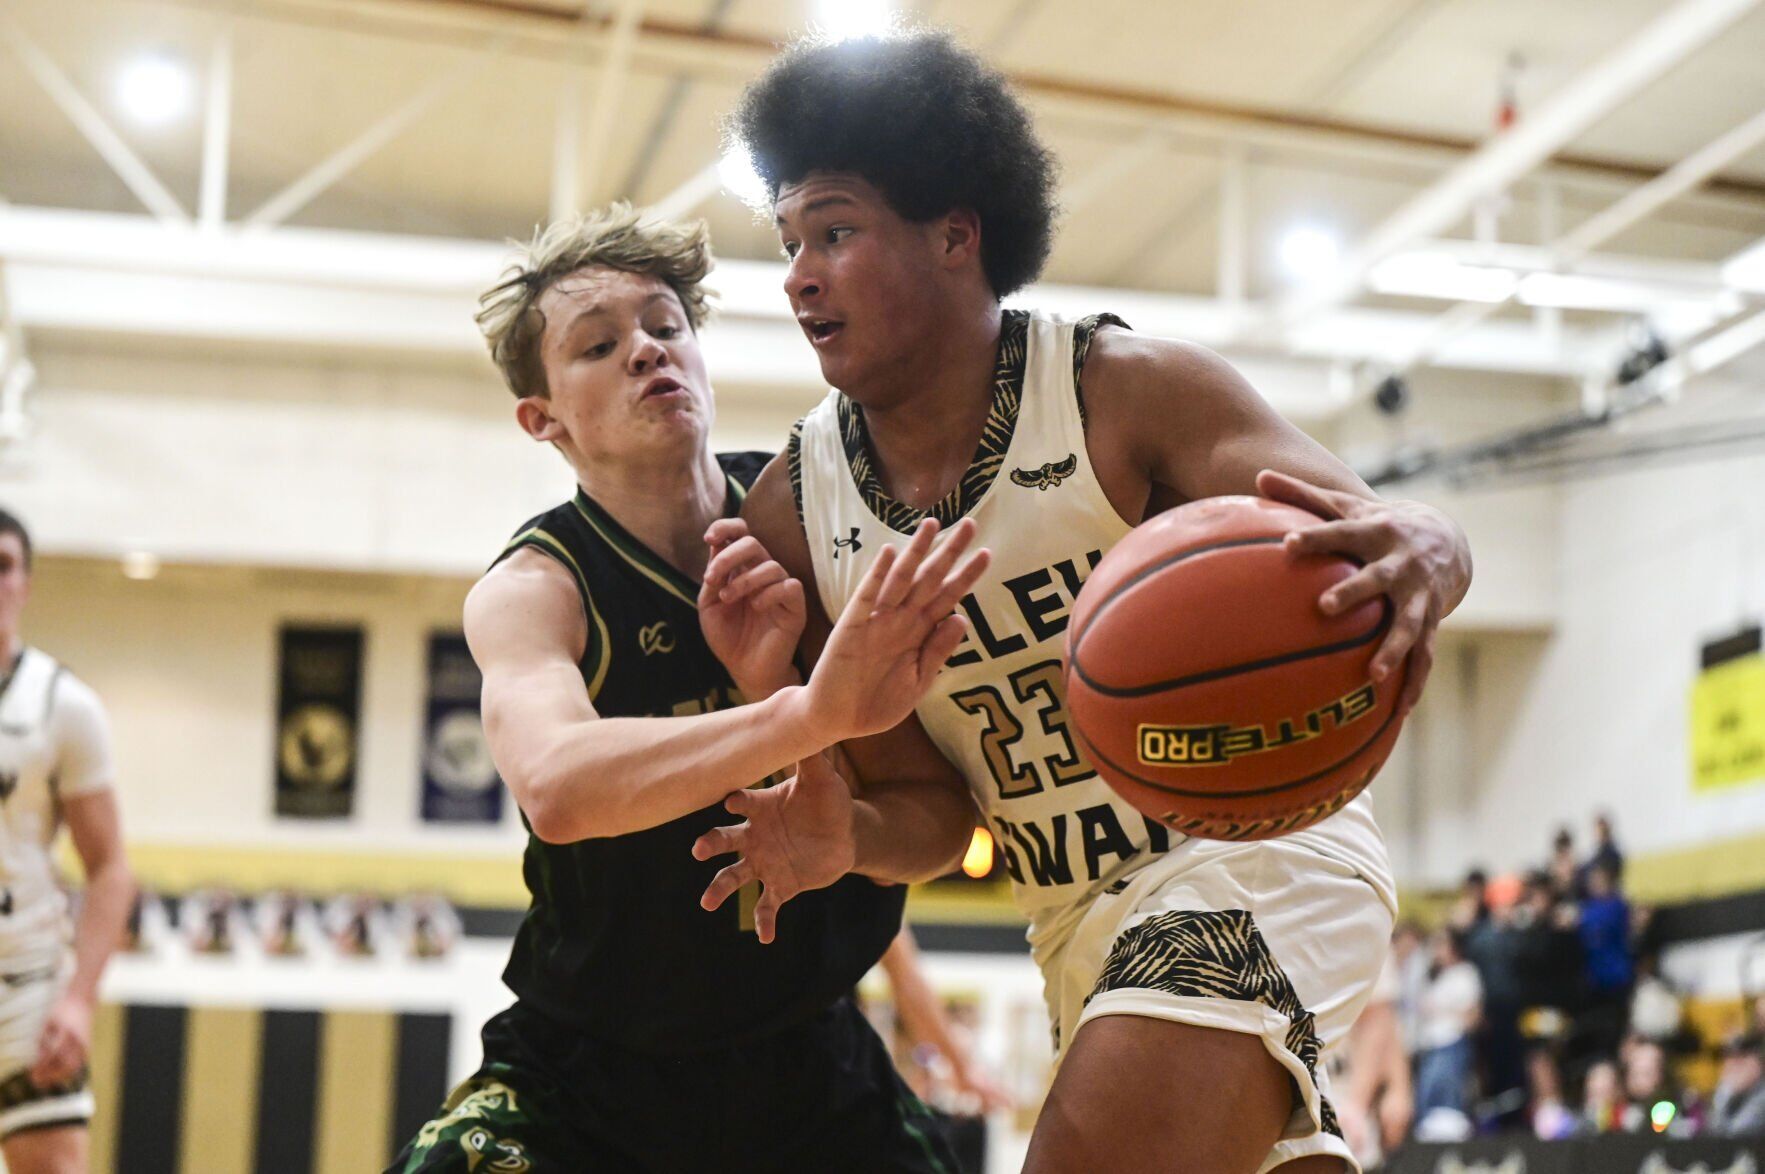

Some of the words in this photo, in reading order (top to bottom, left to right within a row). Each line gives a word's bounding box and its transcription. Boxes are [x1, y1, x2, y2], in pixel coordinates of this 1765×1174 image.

[949, 659, 1098, 800] 23
[1143, 730, 1214, 761] PRO
[1221, 684, 1377, 757] ELITE
